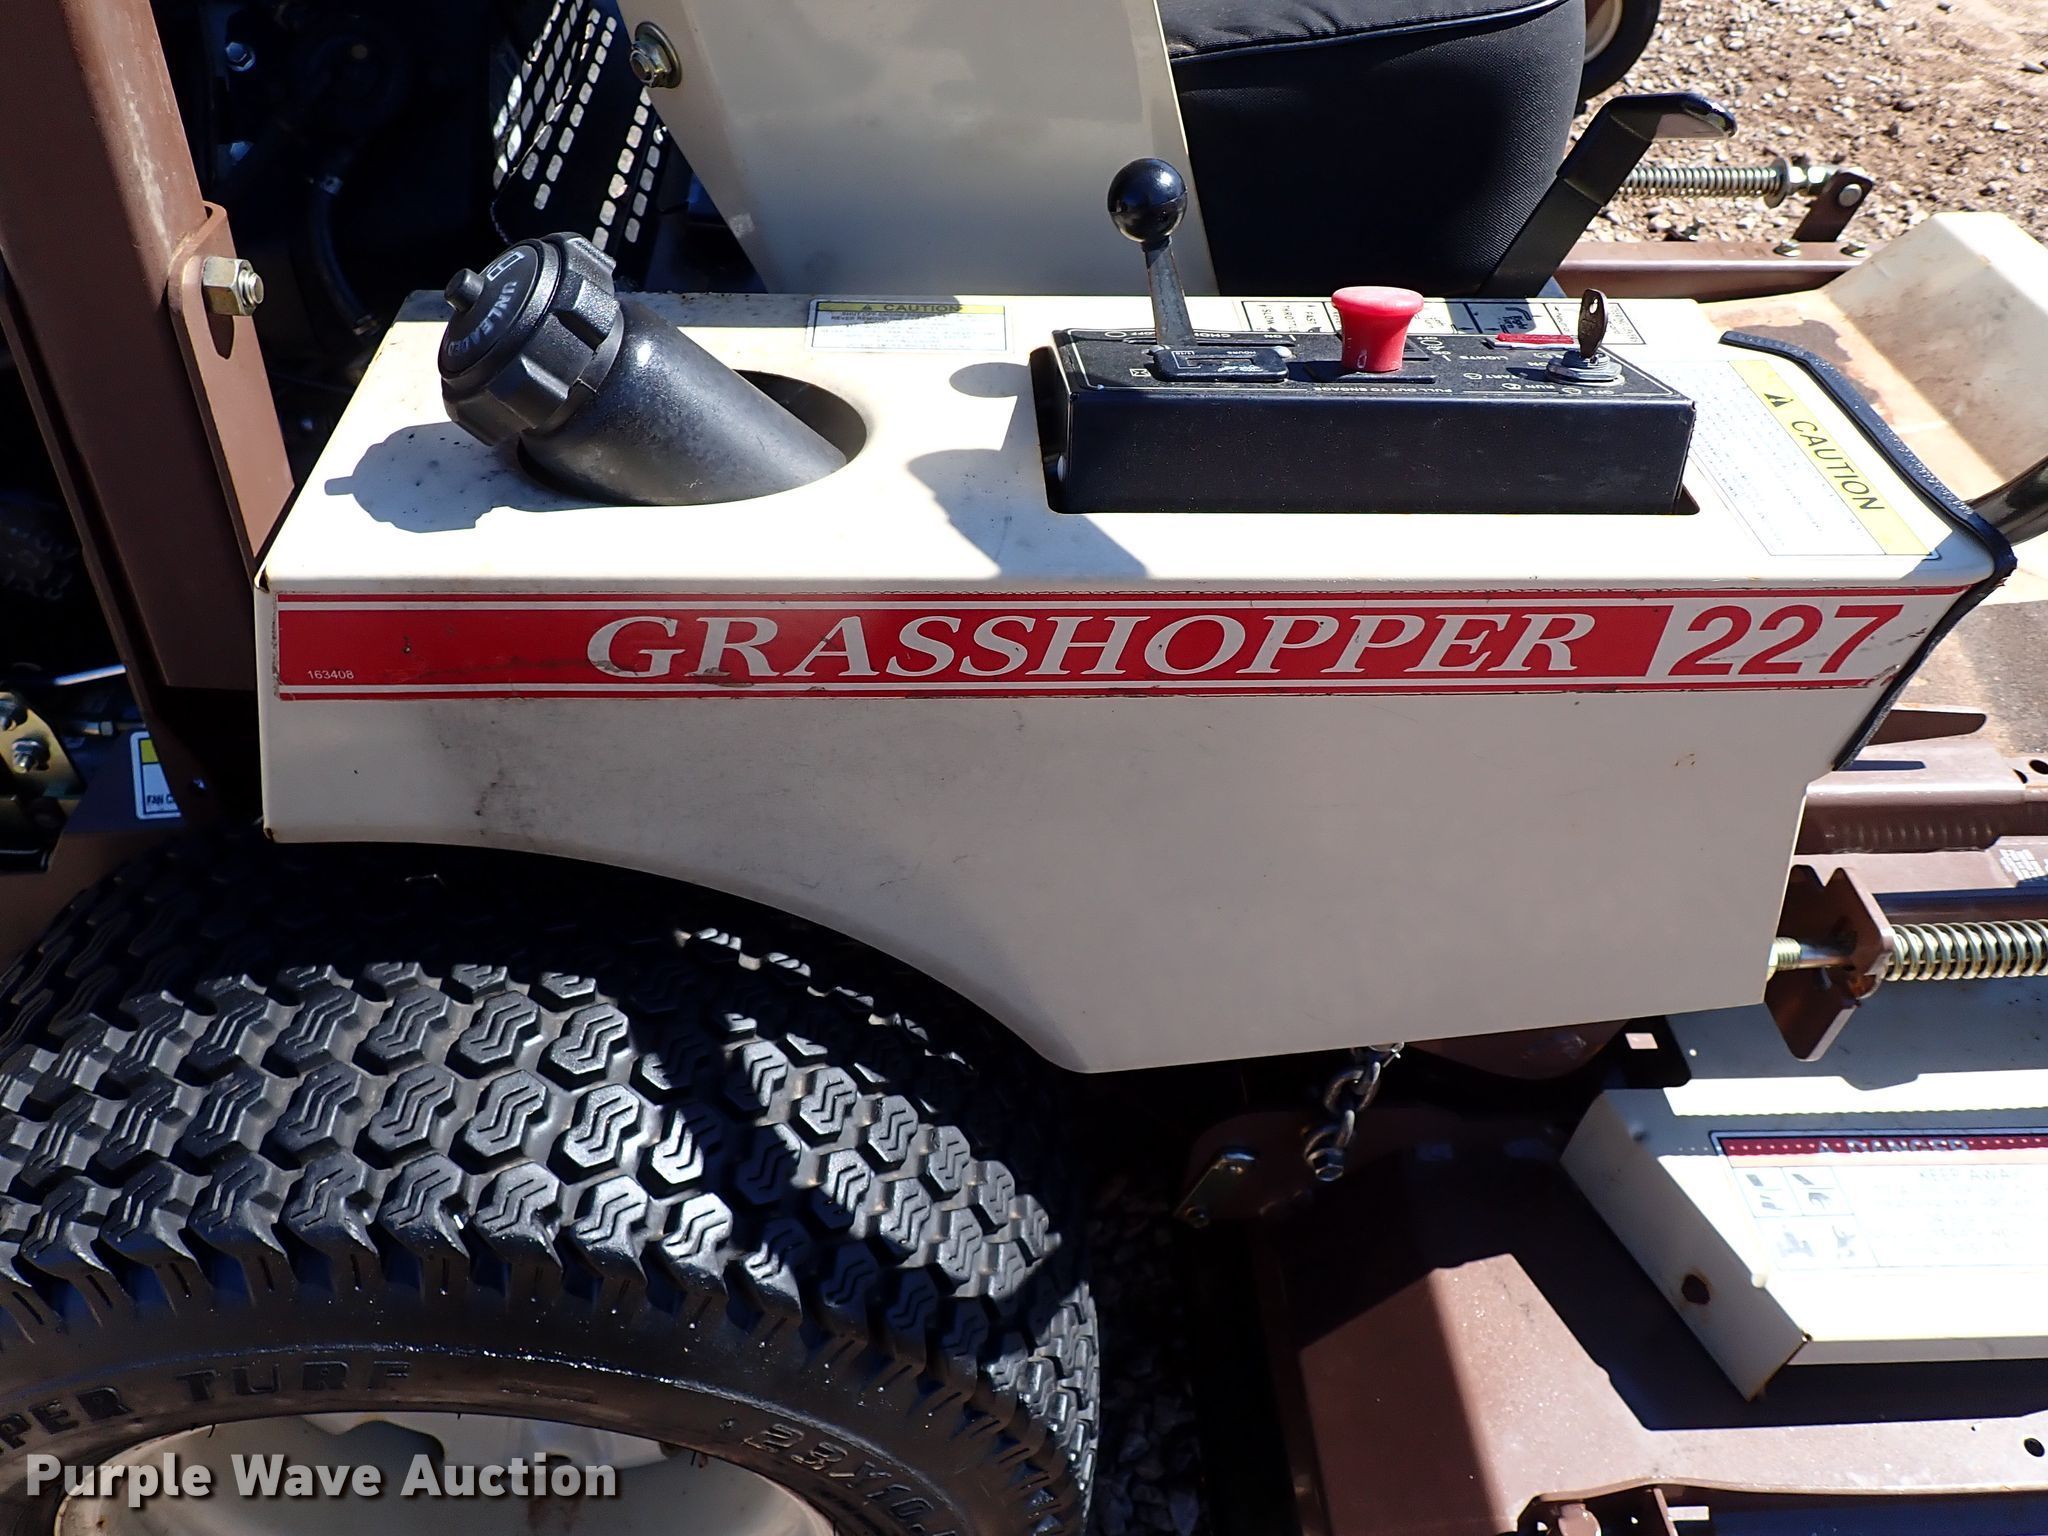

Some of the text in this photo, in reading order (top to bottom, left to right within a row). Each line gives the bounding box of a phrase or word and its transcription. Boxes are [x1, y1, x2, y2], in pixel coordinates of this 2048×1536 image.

[1790, 419, 1887, 511] CAUTION
[307, 669, 355, 680] 163408
[586, 612, 1596, 679] GRASSHOPPER
[1667, 604, 1904, 676] 227
[0, 1360, 411, 1455] PER TURF
